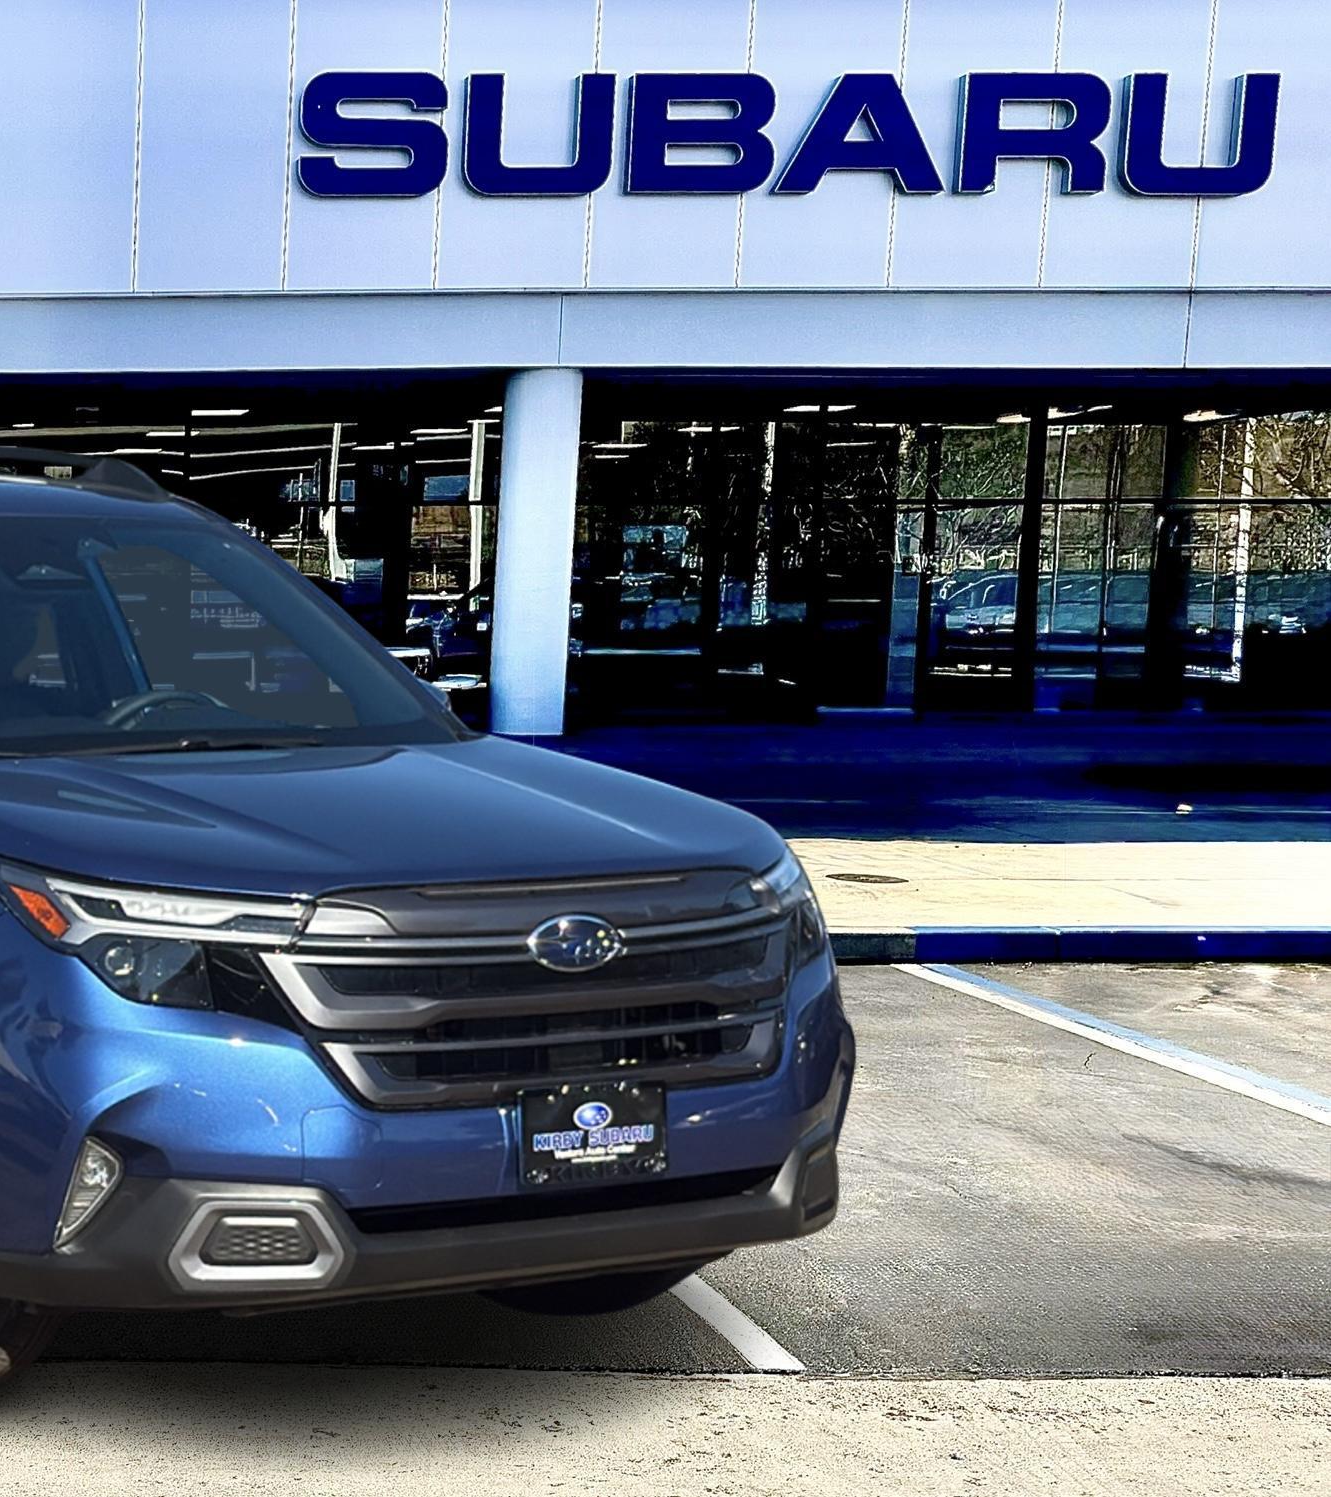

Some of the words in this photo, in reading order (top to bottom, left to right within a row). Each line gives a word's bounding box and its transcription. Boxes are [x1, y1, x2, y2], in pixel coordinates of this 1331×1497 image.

[296, 71, 1282, 201] SUBARU
[533, 1130, 584, 1152] KIRBY
[589, 1125, 654, 1146] SUBARU
